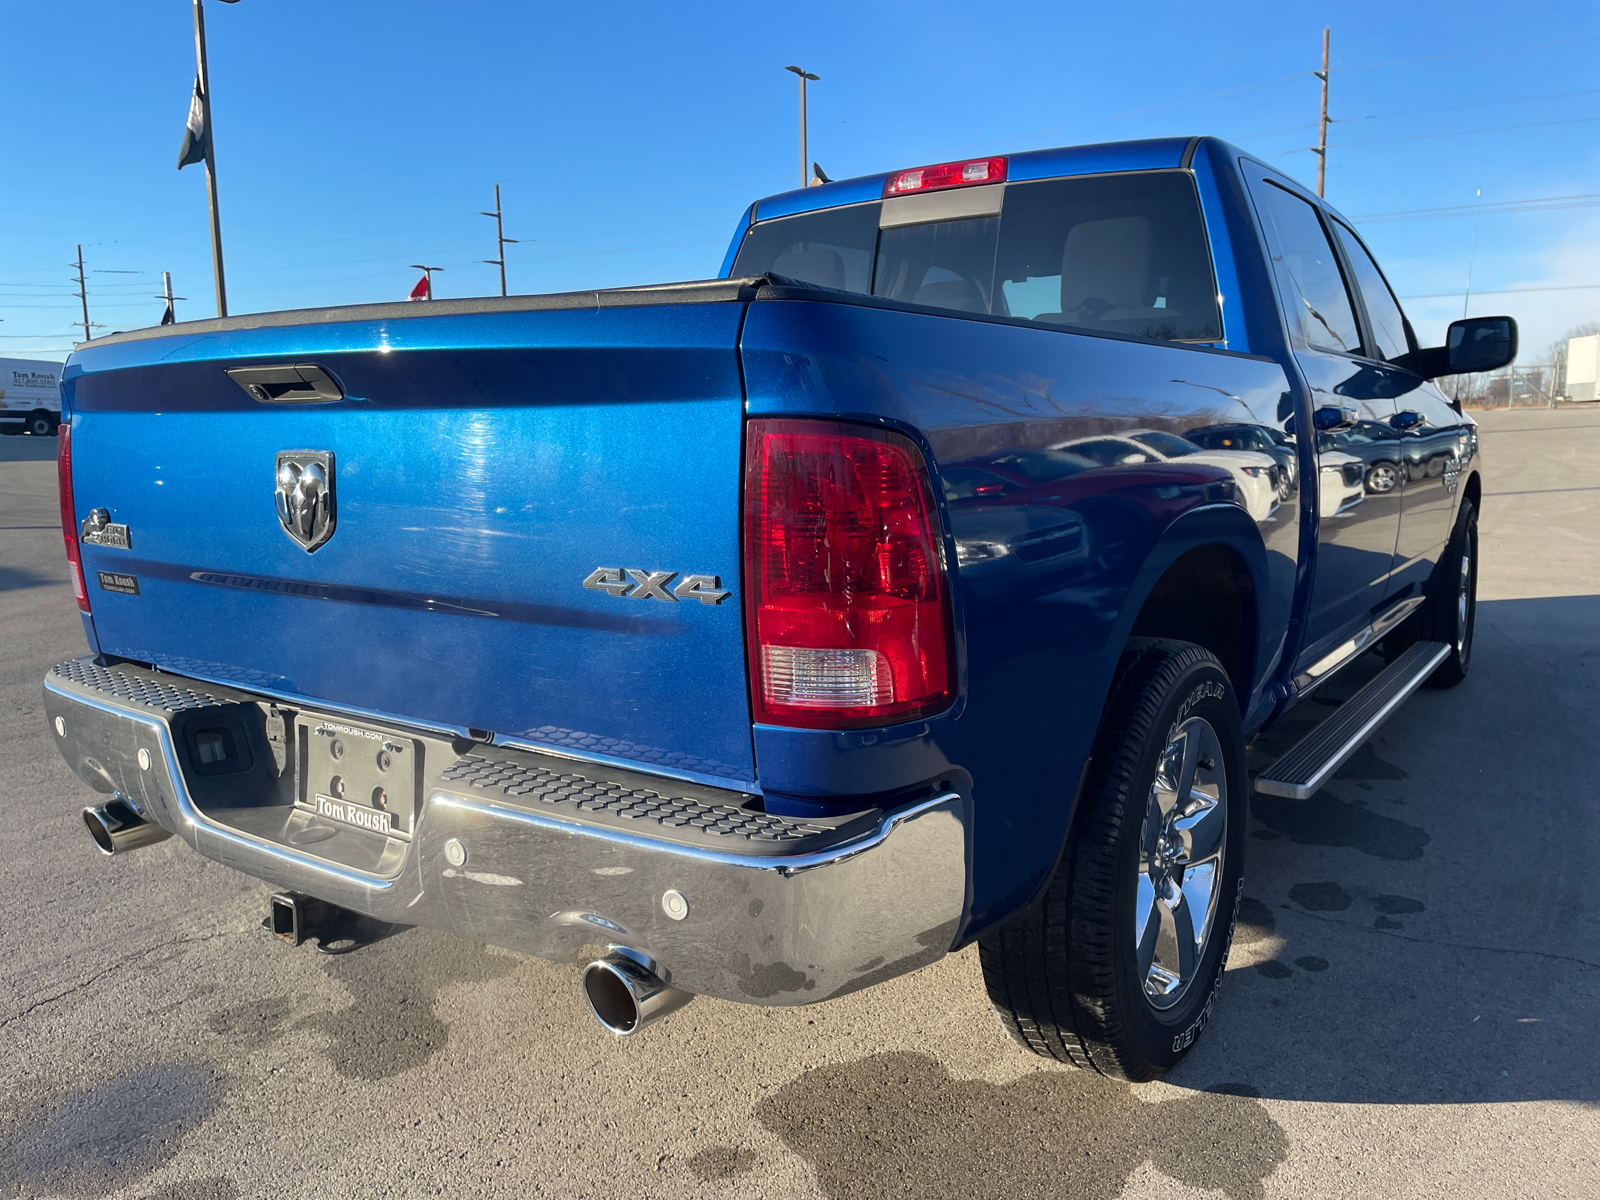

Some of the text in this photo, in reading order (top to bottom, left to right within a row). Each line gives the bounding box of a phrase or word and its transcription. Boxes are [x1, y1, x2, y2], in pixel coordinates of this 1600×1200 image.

[99, 573, 135, 588] Tom Roush
[322, 722, 383, 741] TOMROUSH.COM
[317, 797, 391, 833] Tom Roush
